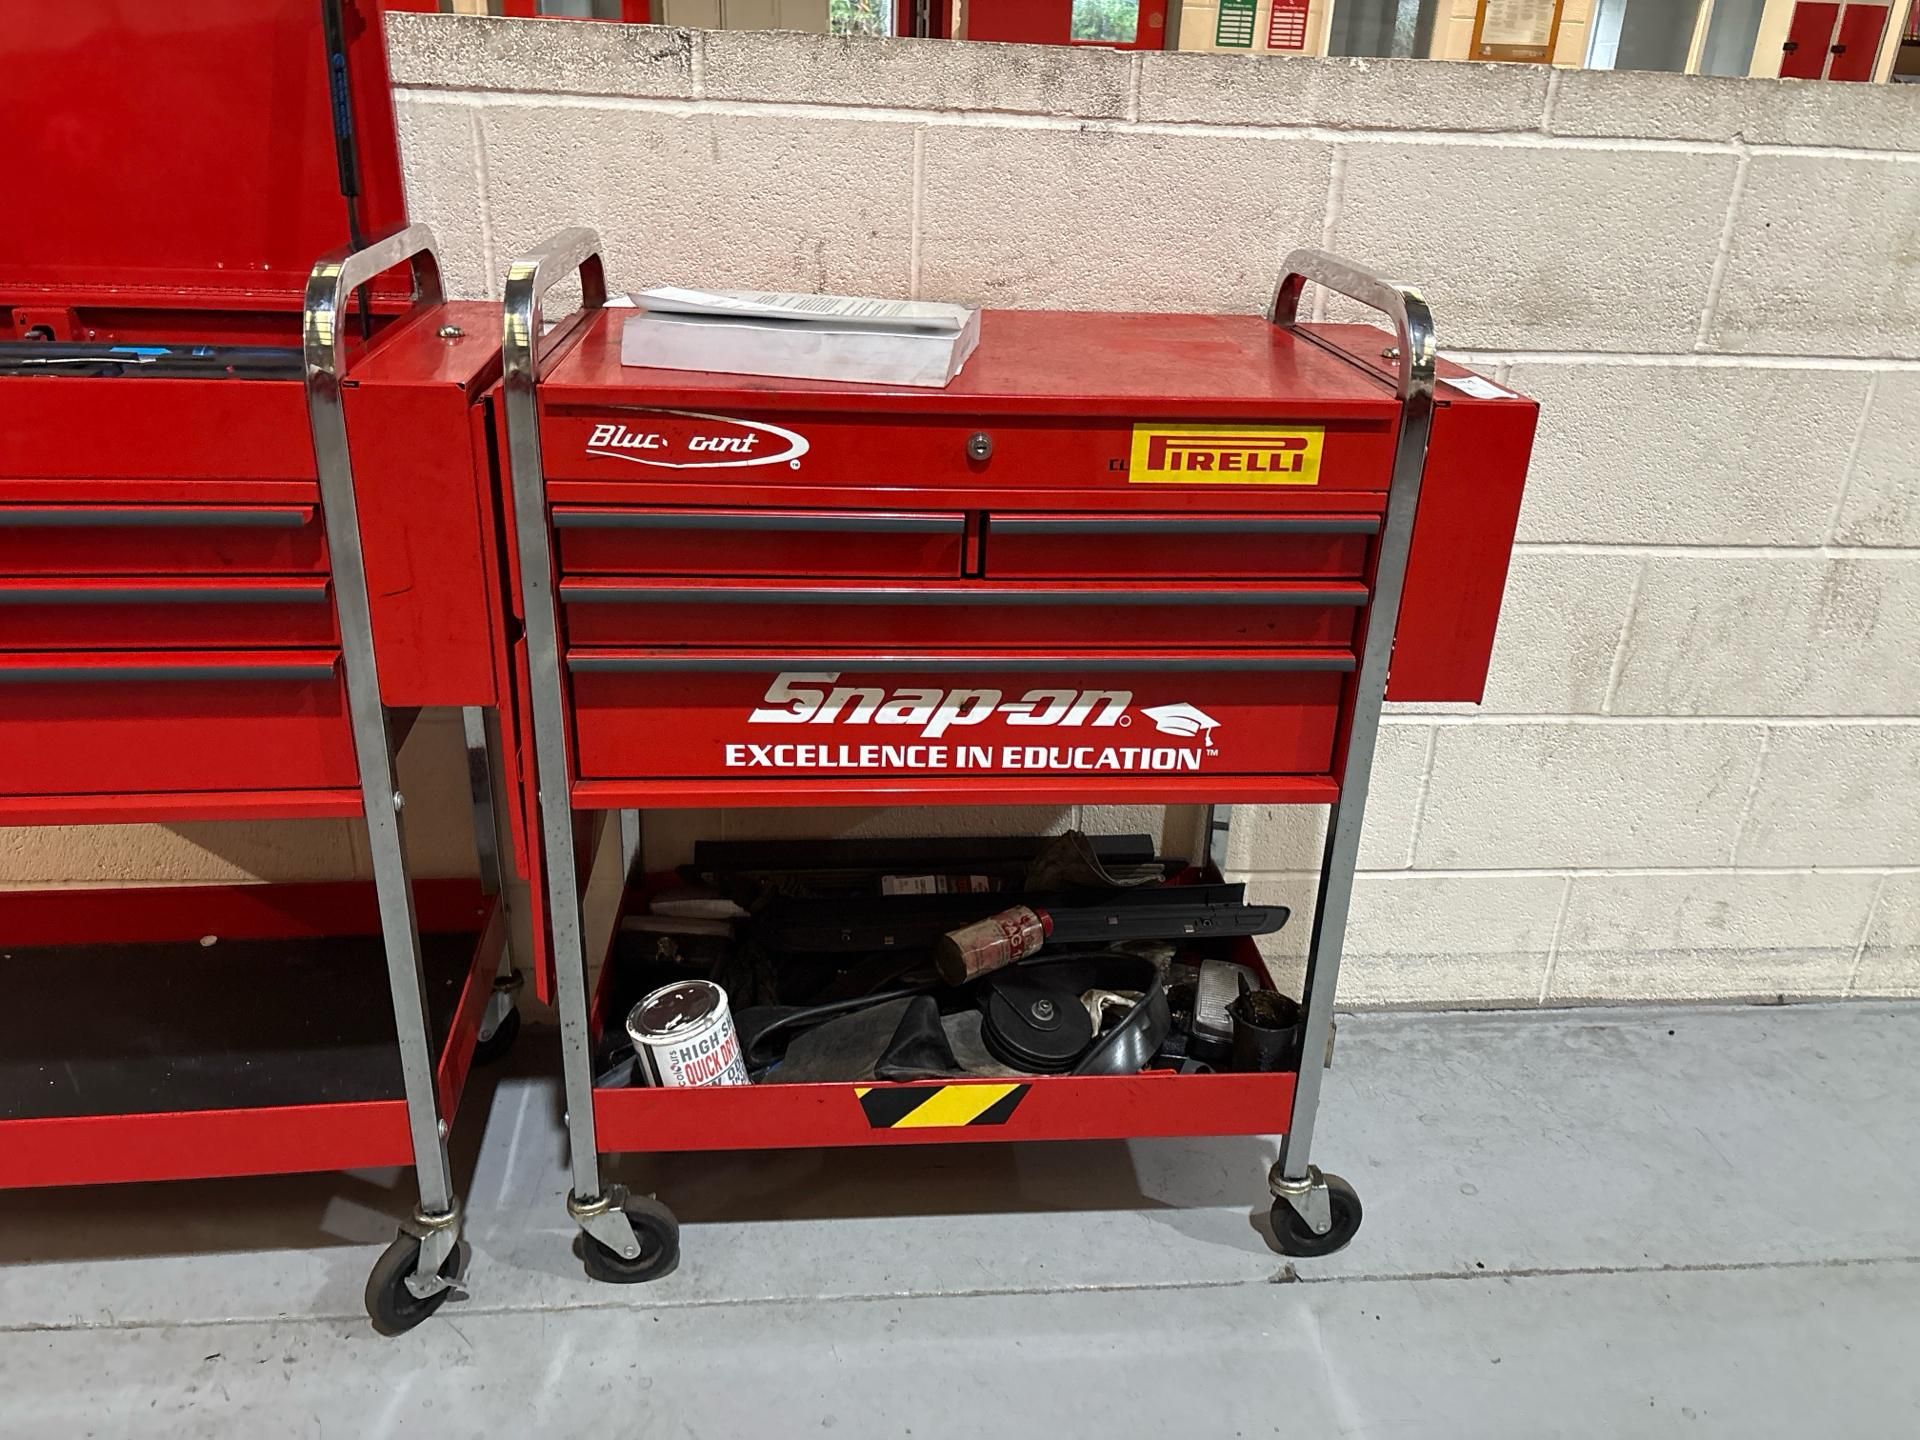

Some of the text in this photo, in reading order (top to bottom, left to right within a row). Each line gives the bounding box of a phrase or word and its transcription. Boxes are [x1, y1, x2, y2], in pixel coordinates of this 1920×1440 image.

[1147, 435, 1309, 472] PIRELLI
[747, 672, 1133, 738] Snap-on
[725, 743, 948, 769] EXCELLENCE
[957, 745, 993, 769] IN
[1002, 746, 1202, 771] EDUCATION
[679, 1031, 720, 1063] HIGH
[684, 1049, 723, 1086] QUICK
